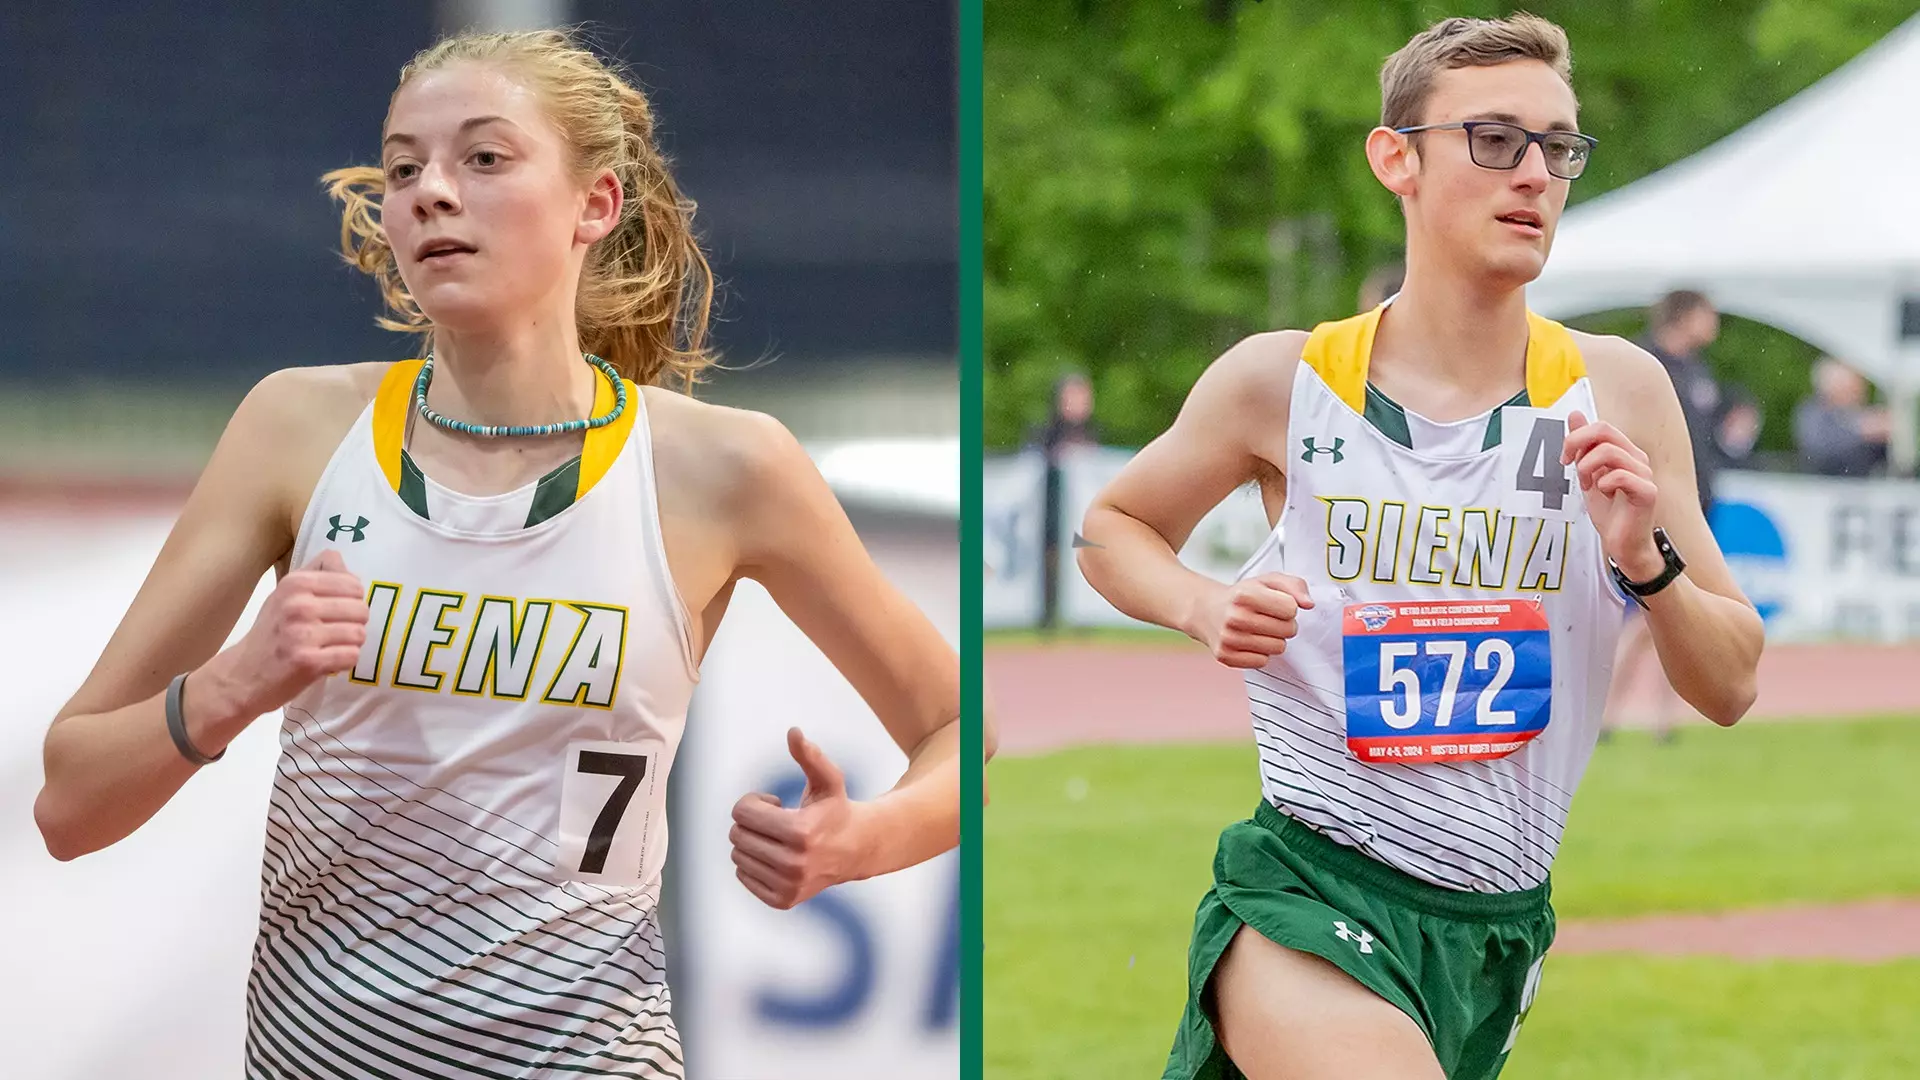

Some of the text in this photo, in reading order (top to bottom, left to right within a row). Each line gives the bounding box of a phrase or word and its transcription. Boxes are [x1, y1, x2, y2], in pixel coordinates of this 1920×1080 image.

[1516, 417, 1570, 510] 4
[1313, 495, 1570, 592] SIENA
[340, 580, 630, 711] IENA
[1379, 638, 1516, 730] 572
[1369, 747, 1386, 757] MAY
[1403, 745, 1422, 756] 2024
[577, 750, 648, 875] 7
